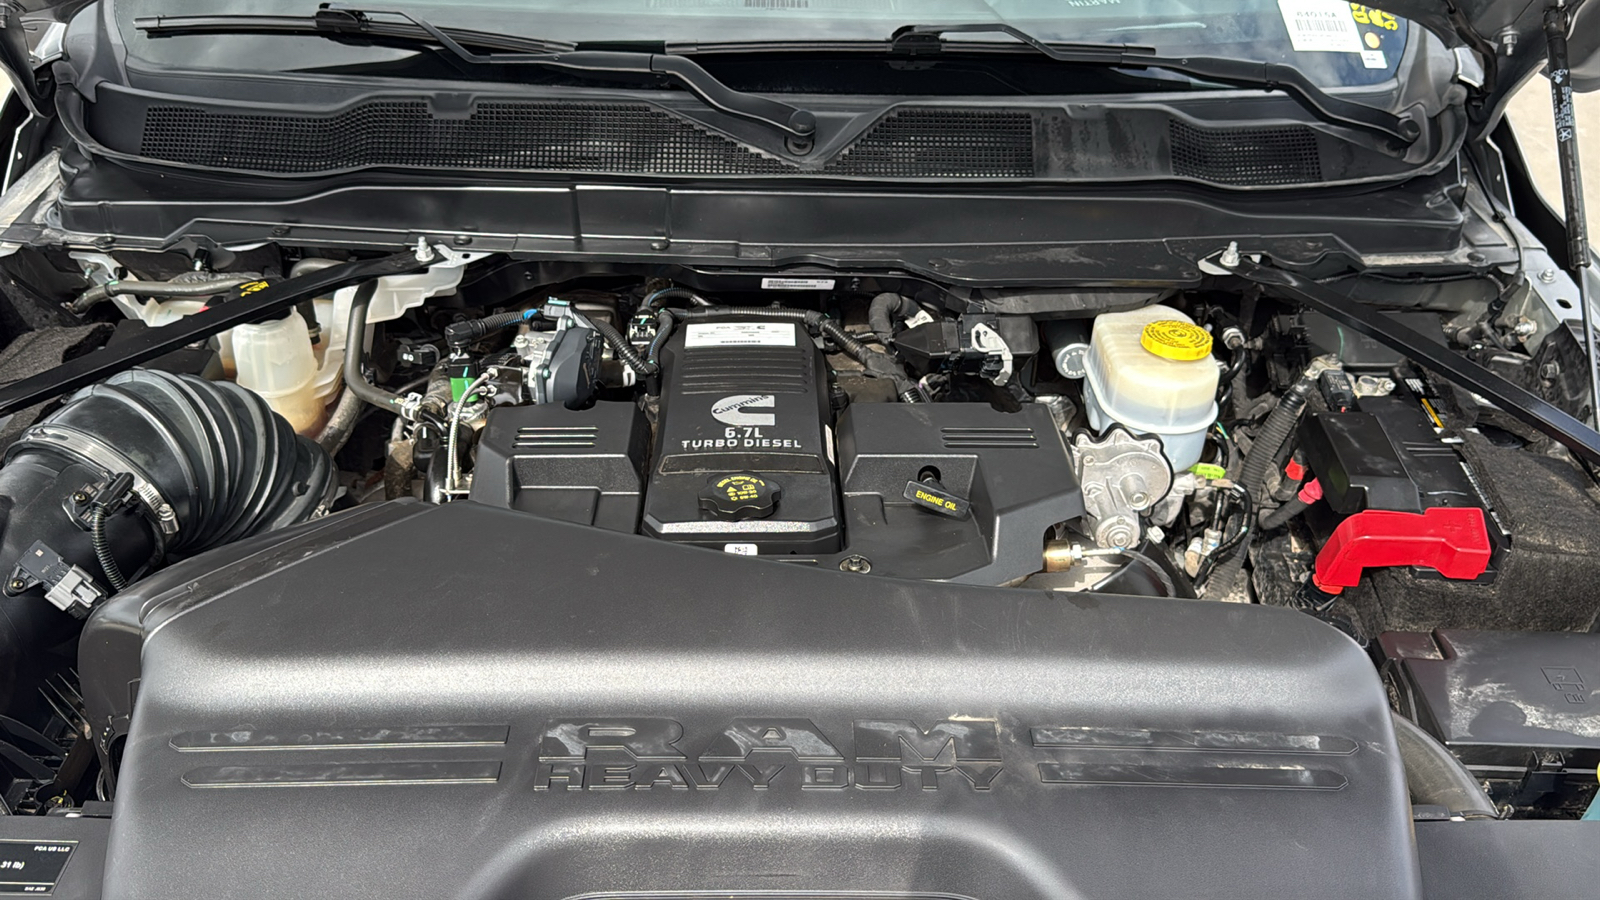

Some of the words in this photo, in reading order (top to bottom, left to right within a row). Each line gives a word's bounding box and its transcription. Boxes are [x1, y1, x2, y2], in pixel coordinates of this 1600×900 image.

[712, 394, 769, 415] Cummins
[724, 427, 764, 438] 6.7L
[681, 439, 738, 449] TURBO
[743, 439, 802, 448] DIESEL
[915, 490, 945, 507] ENGINE
[944, 500, 957, 511] OIL
[539, 716, 1004, 762] RAM
[533, 763, 787, 792] HEAVY
[800, 763, 1005, 791] DUTY
